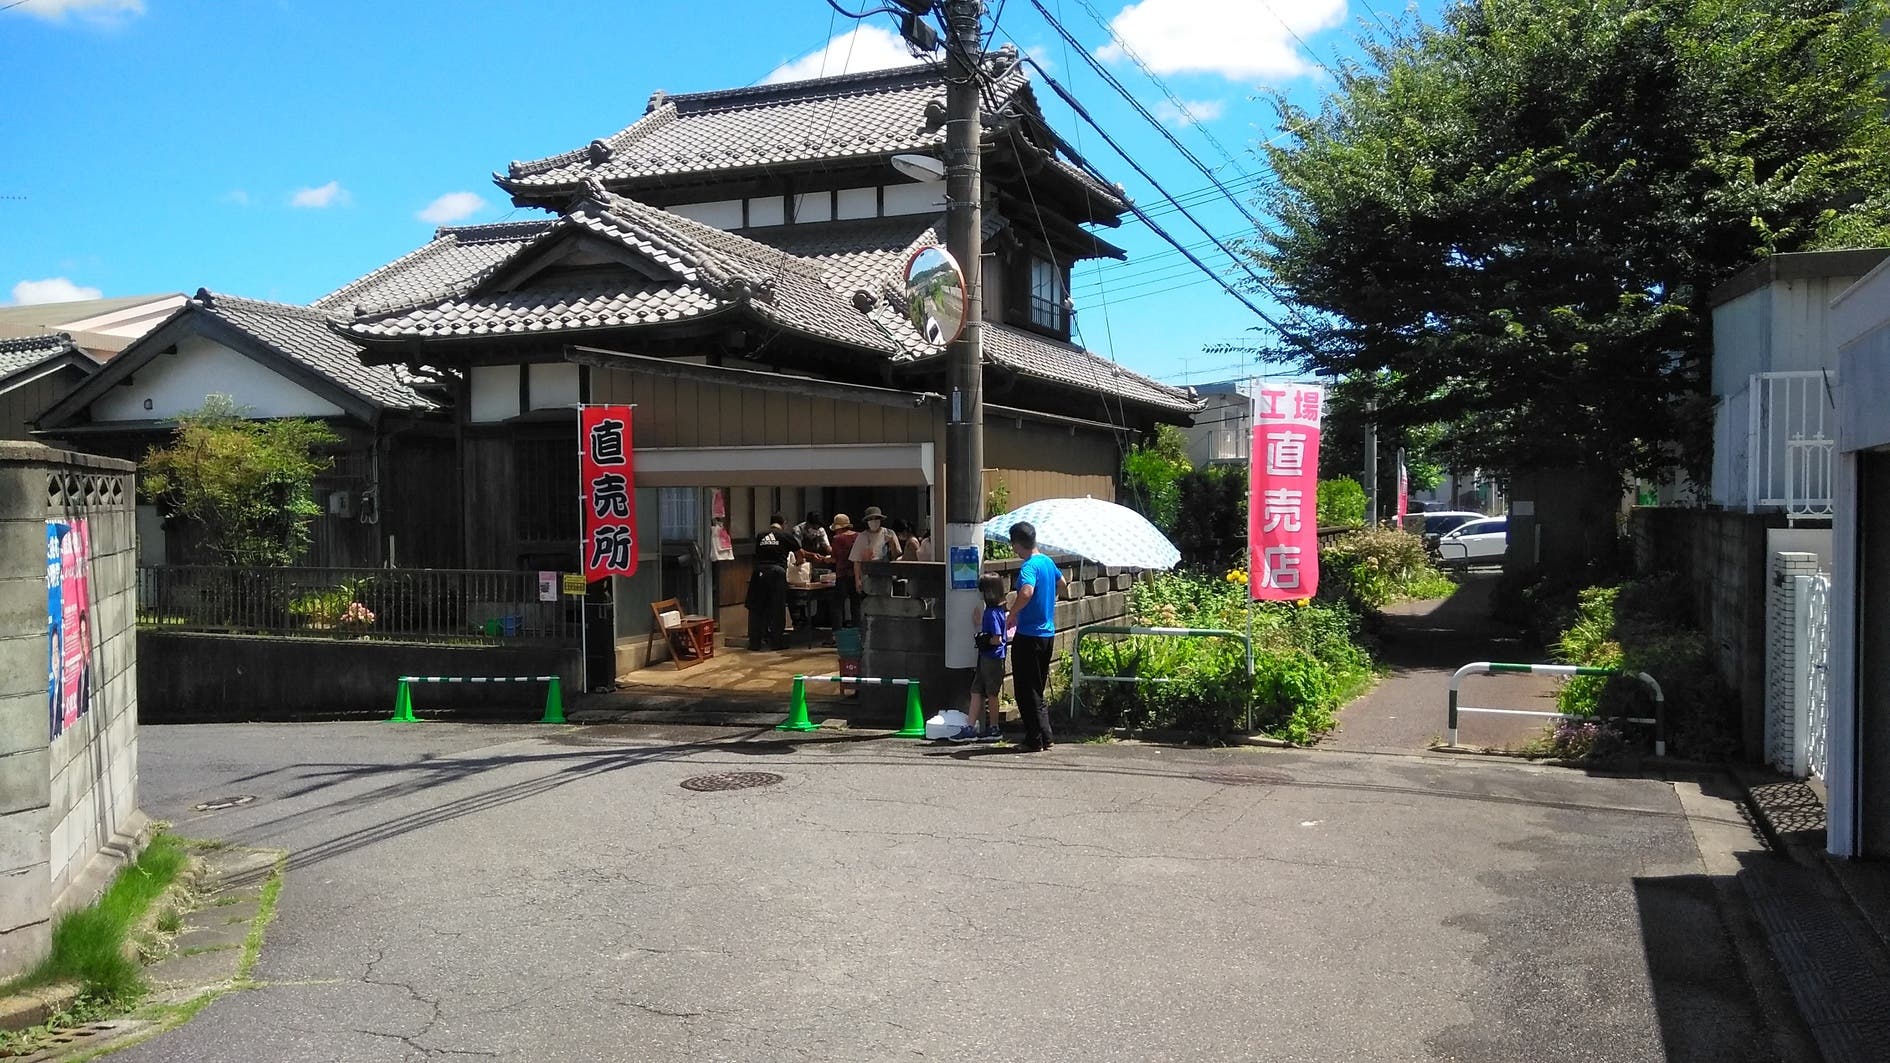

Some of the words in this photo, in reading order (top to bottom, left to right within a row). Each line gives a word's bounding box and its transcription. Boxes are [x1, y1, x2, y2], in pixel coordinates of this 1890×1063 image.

[1260, 390, 1318, 421] 工場
[590, 419, 632, 570] 直売所
[1261, 430, 1307, 589] 直売店
